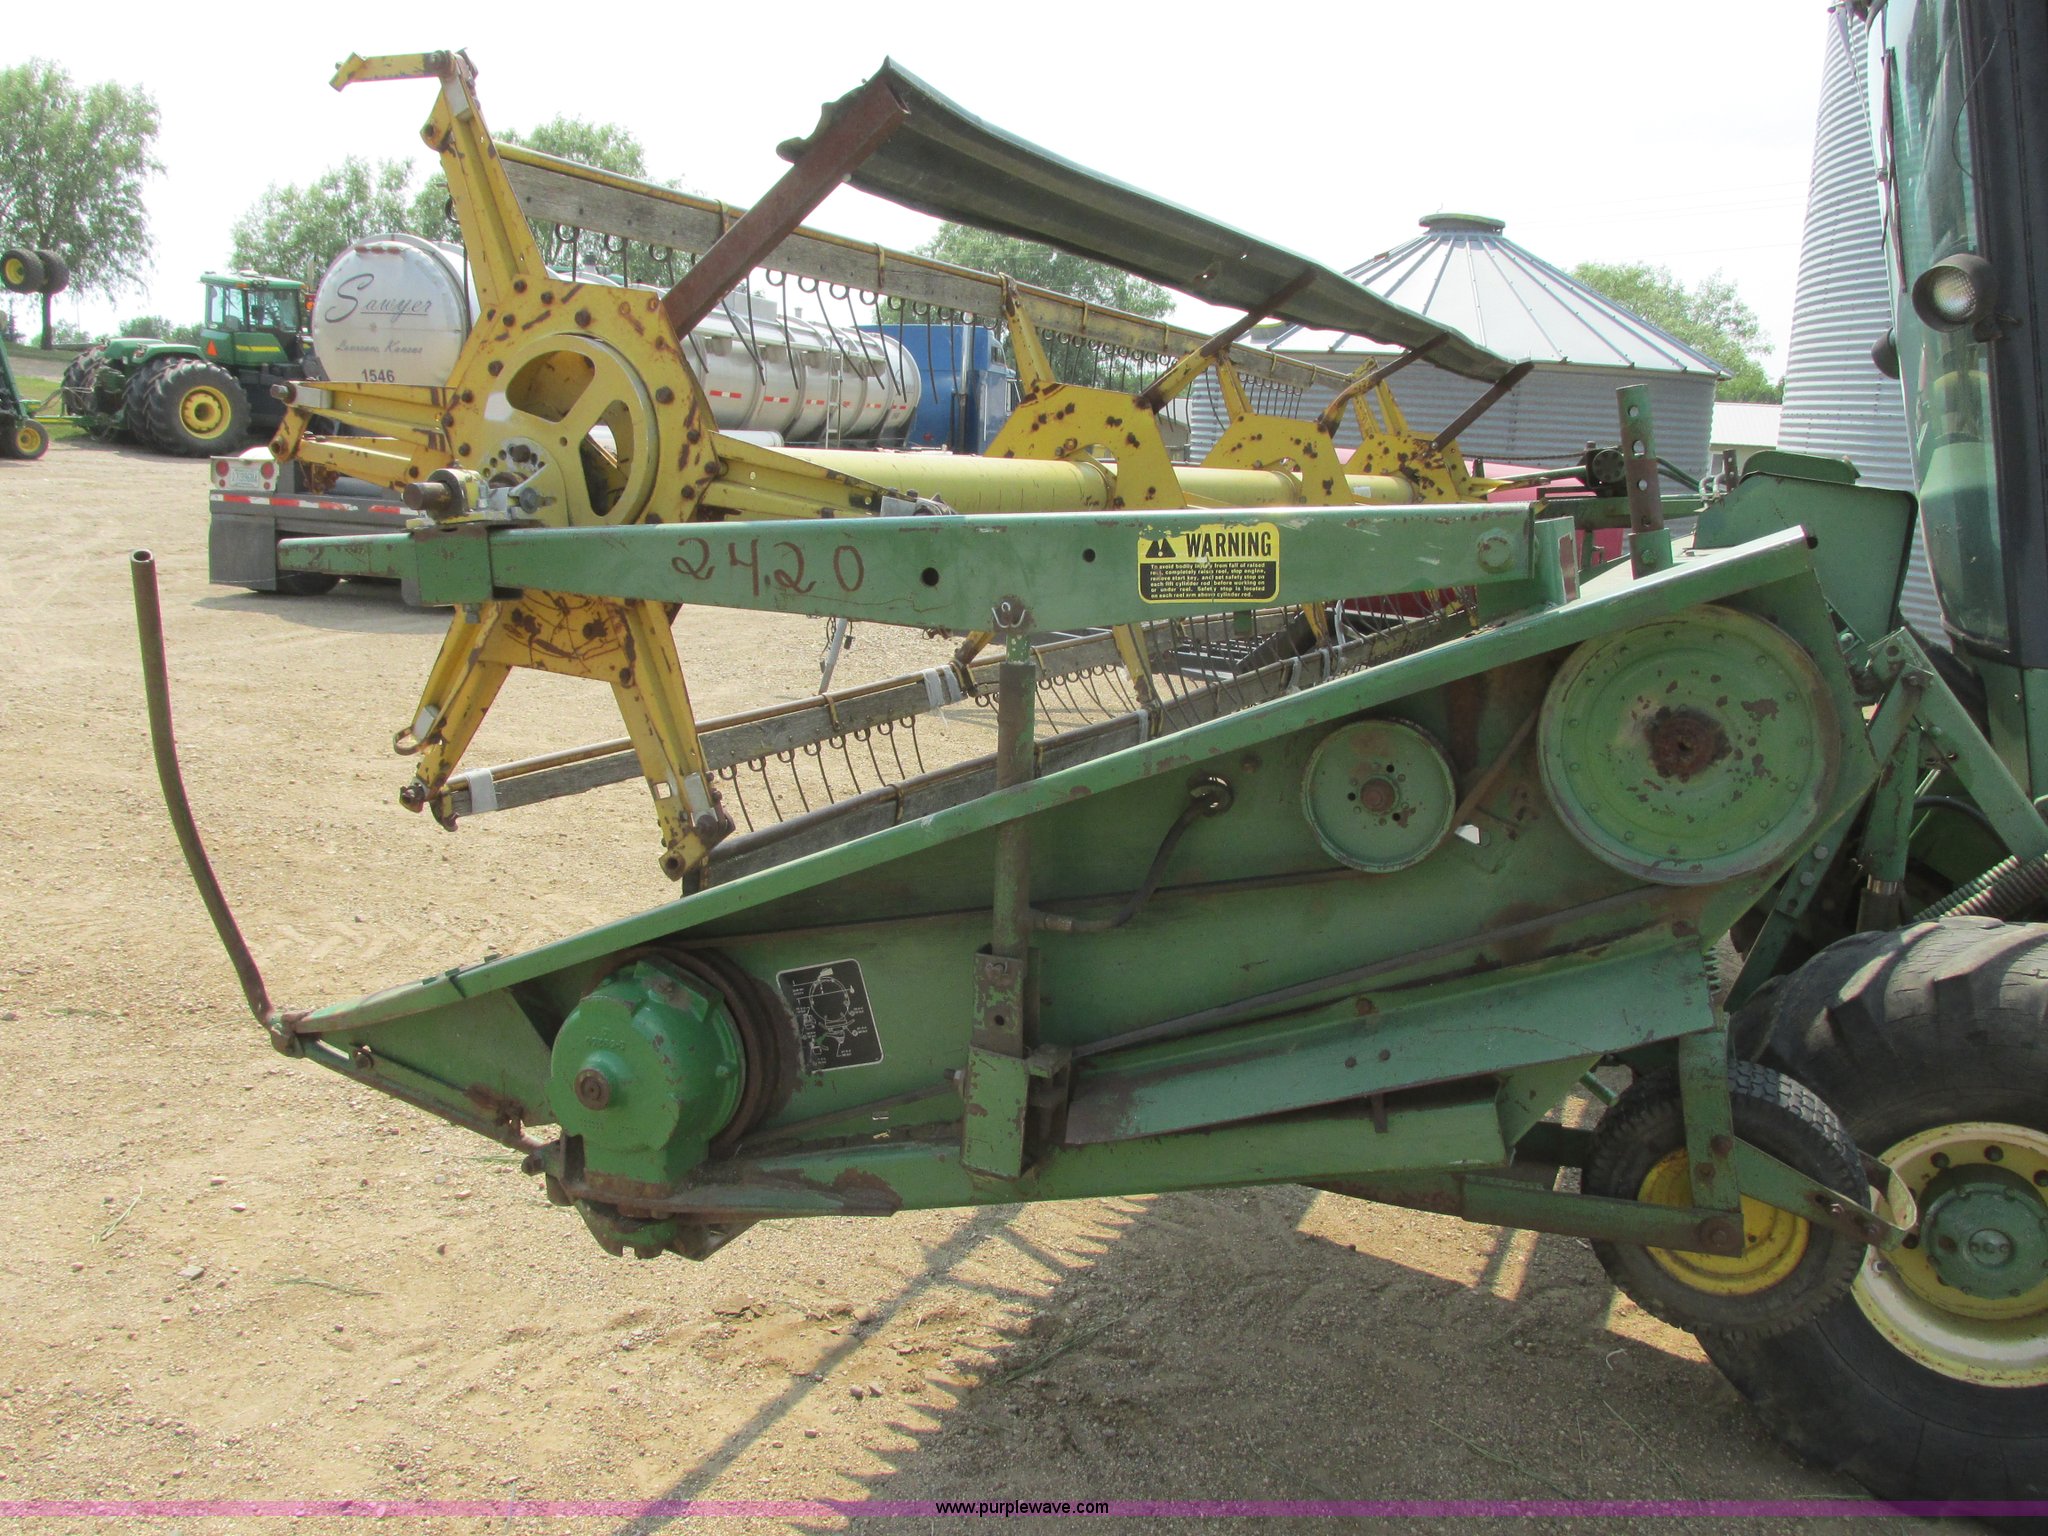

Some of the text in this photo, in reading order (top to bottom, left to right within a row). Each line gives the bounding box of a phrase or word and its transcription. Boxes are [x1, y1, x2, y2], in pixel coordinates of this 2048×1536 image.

[325, 273, 432, 323] Sawyer
[361, 368, 395, 382] 1546
[1185, 531, 1272, 557] WARNING
[1175, 580, 1199, 588] cylinder
